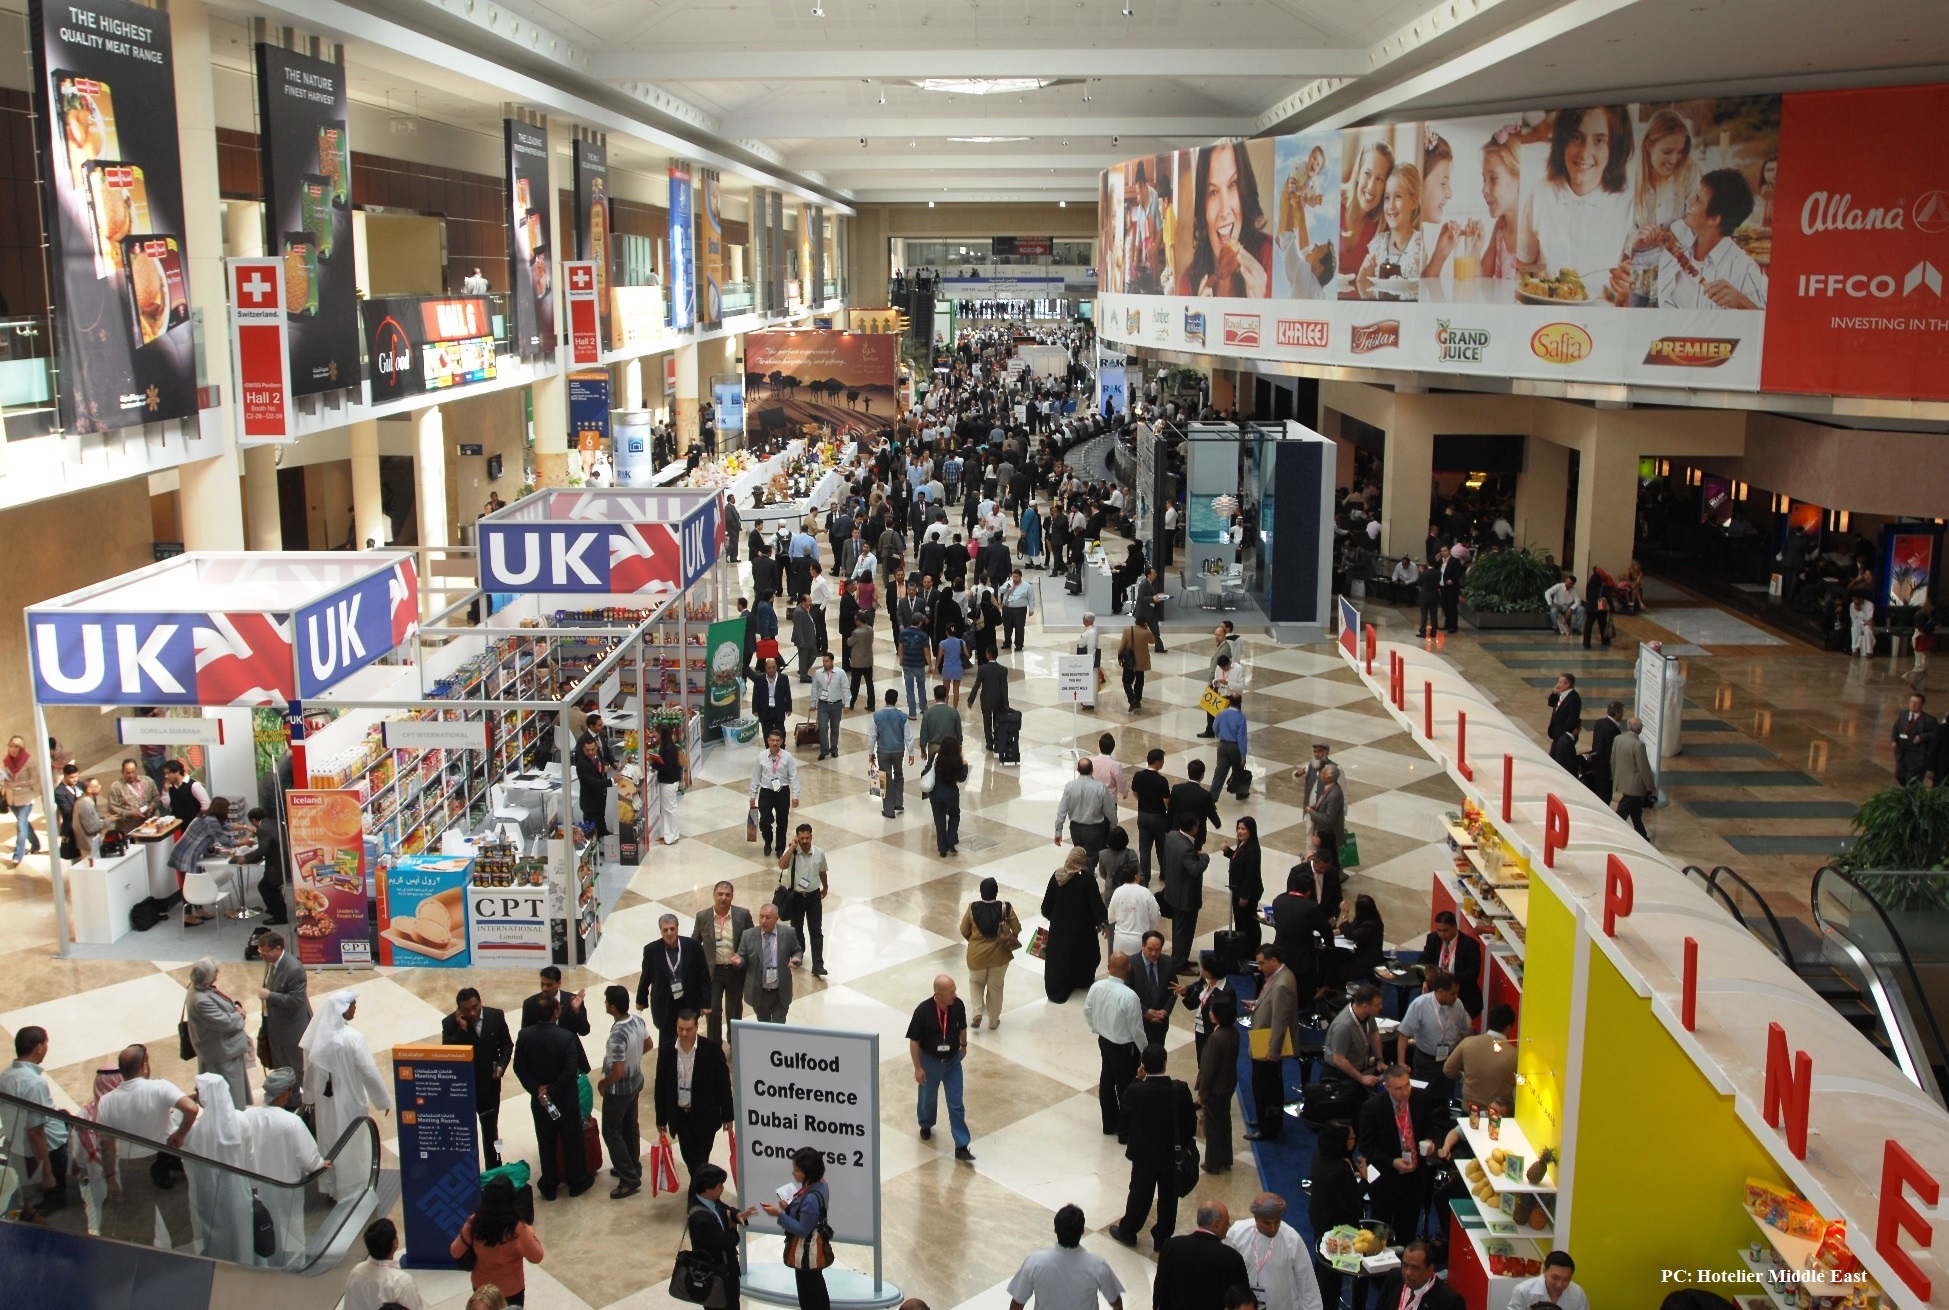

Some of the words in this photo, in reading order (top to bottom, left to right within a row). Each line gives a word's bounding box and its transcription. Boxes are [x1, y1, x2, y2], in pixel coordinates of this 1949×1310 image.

[69, 6, 97, 28] THE
[100, 15, 152, 43] HIGHEST
[60, 27, 103, 49] QUALITY
[105, 39, 130, 55] MEAT
[132, 45, 163, 64] RANGE
[284, 67, 301, 83] THE
[303, 72, 333, 91] NATURE
[285, 84, 307, 99] FINEST
[308, 91, 334, 105] HARVEST
[1801, 191, 1904, 235] Allana
[1799, 275, 1896, 297] IFFCO
[437, 304, 469, 338] HALL
[1831, 317, 1905, 330] INVESTING
[1909, 319, 1926, 330] IN
[1278, 323, 1328, 345] KHALEEJ
[1353, 325, 1397, 350] Tristar
[1438, 329, 1488, 346] GRAND
[1442, 346, 1479, 360] JUICE
[1537, 333, 1582, 363] Saffa
[1650, 341, 1732, 359] PREMIER
[246, 392, 270, 404] Hall
[272, 392, 280, 404] 2
[685, 515, 706, 578] UK
[489, 533, 602, 585] UK
[308, 592, 367, 681] UK
[36, 624, 187, 694] UK
[290, 715, 303, 724] UK
[293, 796, 322, 804] Iceland
[475, 898, 544, 918] CPT
[342, 943, 368, 951] CPT
[770, 1051, 840, 1072] Gulfood
[754, 1080, 857, 1105] Conference
[748, 1110, 798, 1129] Dubai
[804, 1115, 865, 1136] Rooms
[852, 1151, 863, 1167] 2
